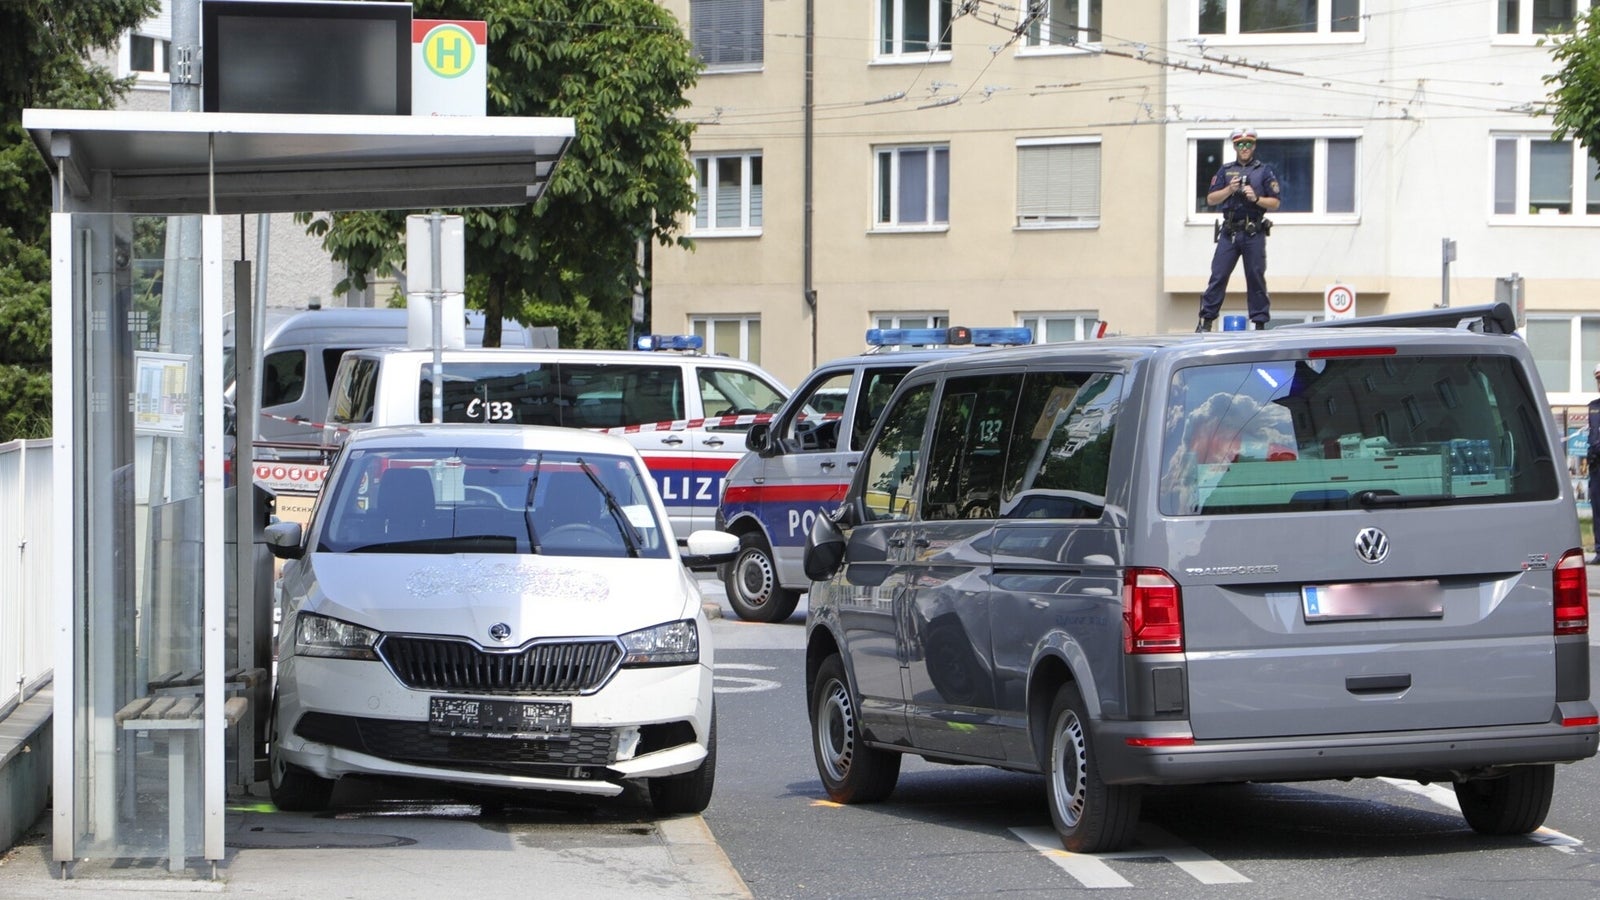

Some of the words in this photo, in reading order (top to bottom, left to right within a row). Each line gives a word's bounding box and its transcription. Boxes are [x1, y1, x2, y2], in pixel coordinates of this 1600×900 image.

[437, 38, 461, 68] H
[1334, 294, 1346, 306] 30
[481, 401, 513, 420] 133
[259, 466, 327, 481] rogr
[652, 476, 726, 500] LIZ
[788, 509, 816, 537] PO
[1185, 564, 1280, 577] TRANSPORTER
